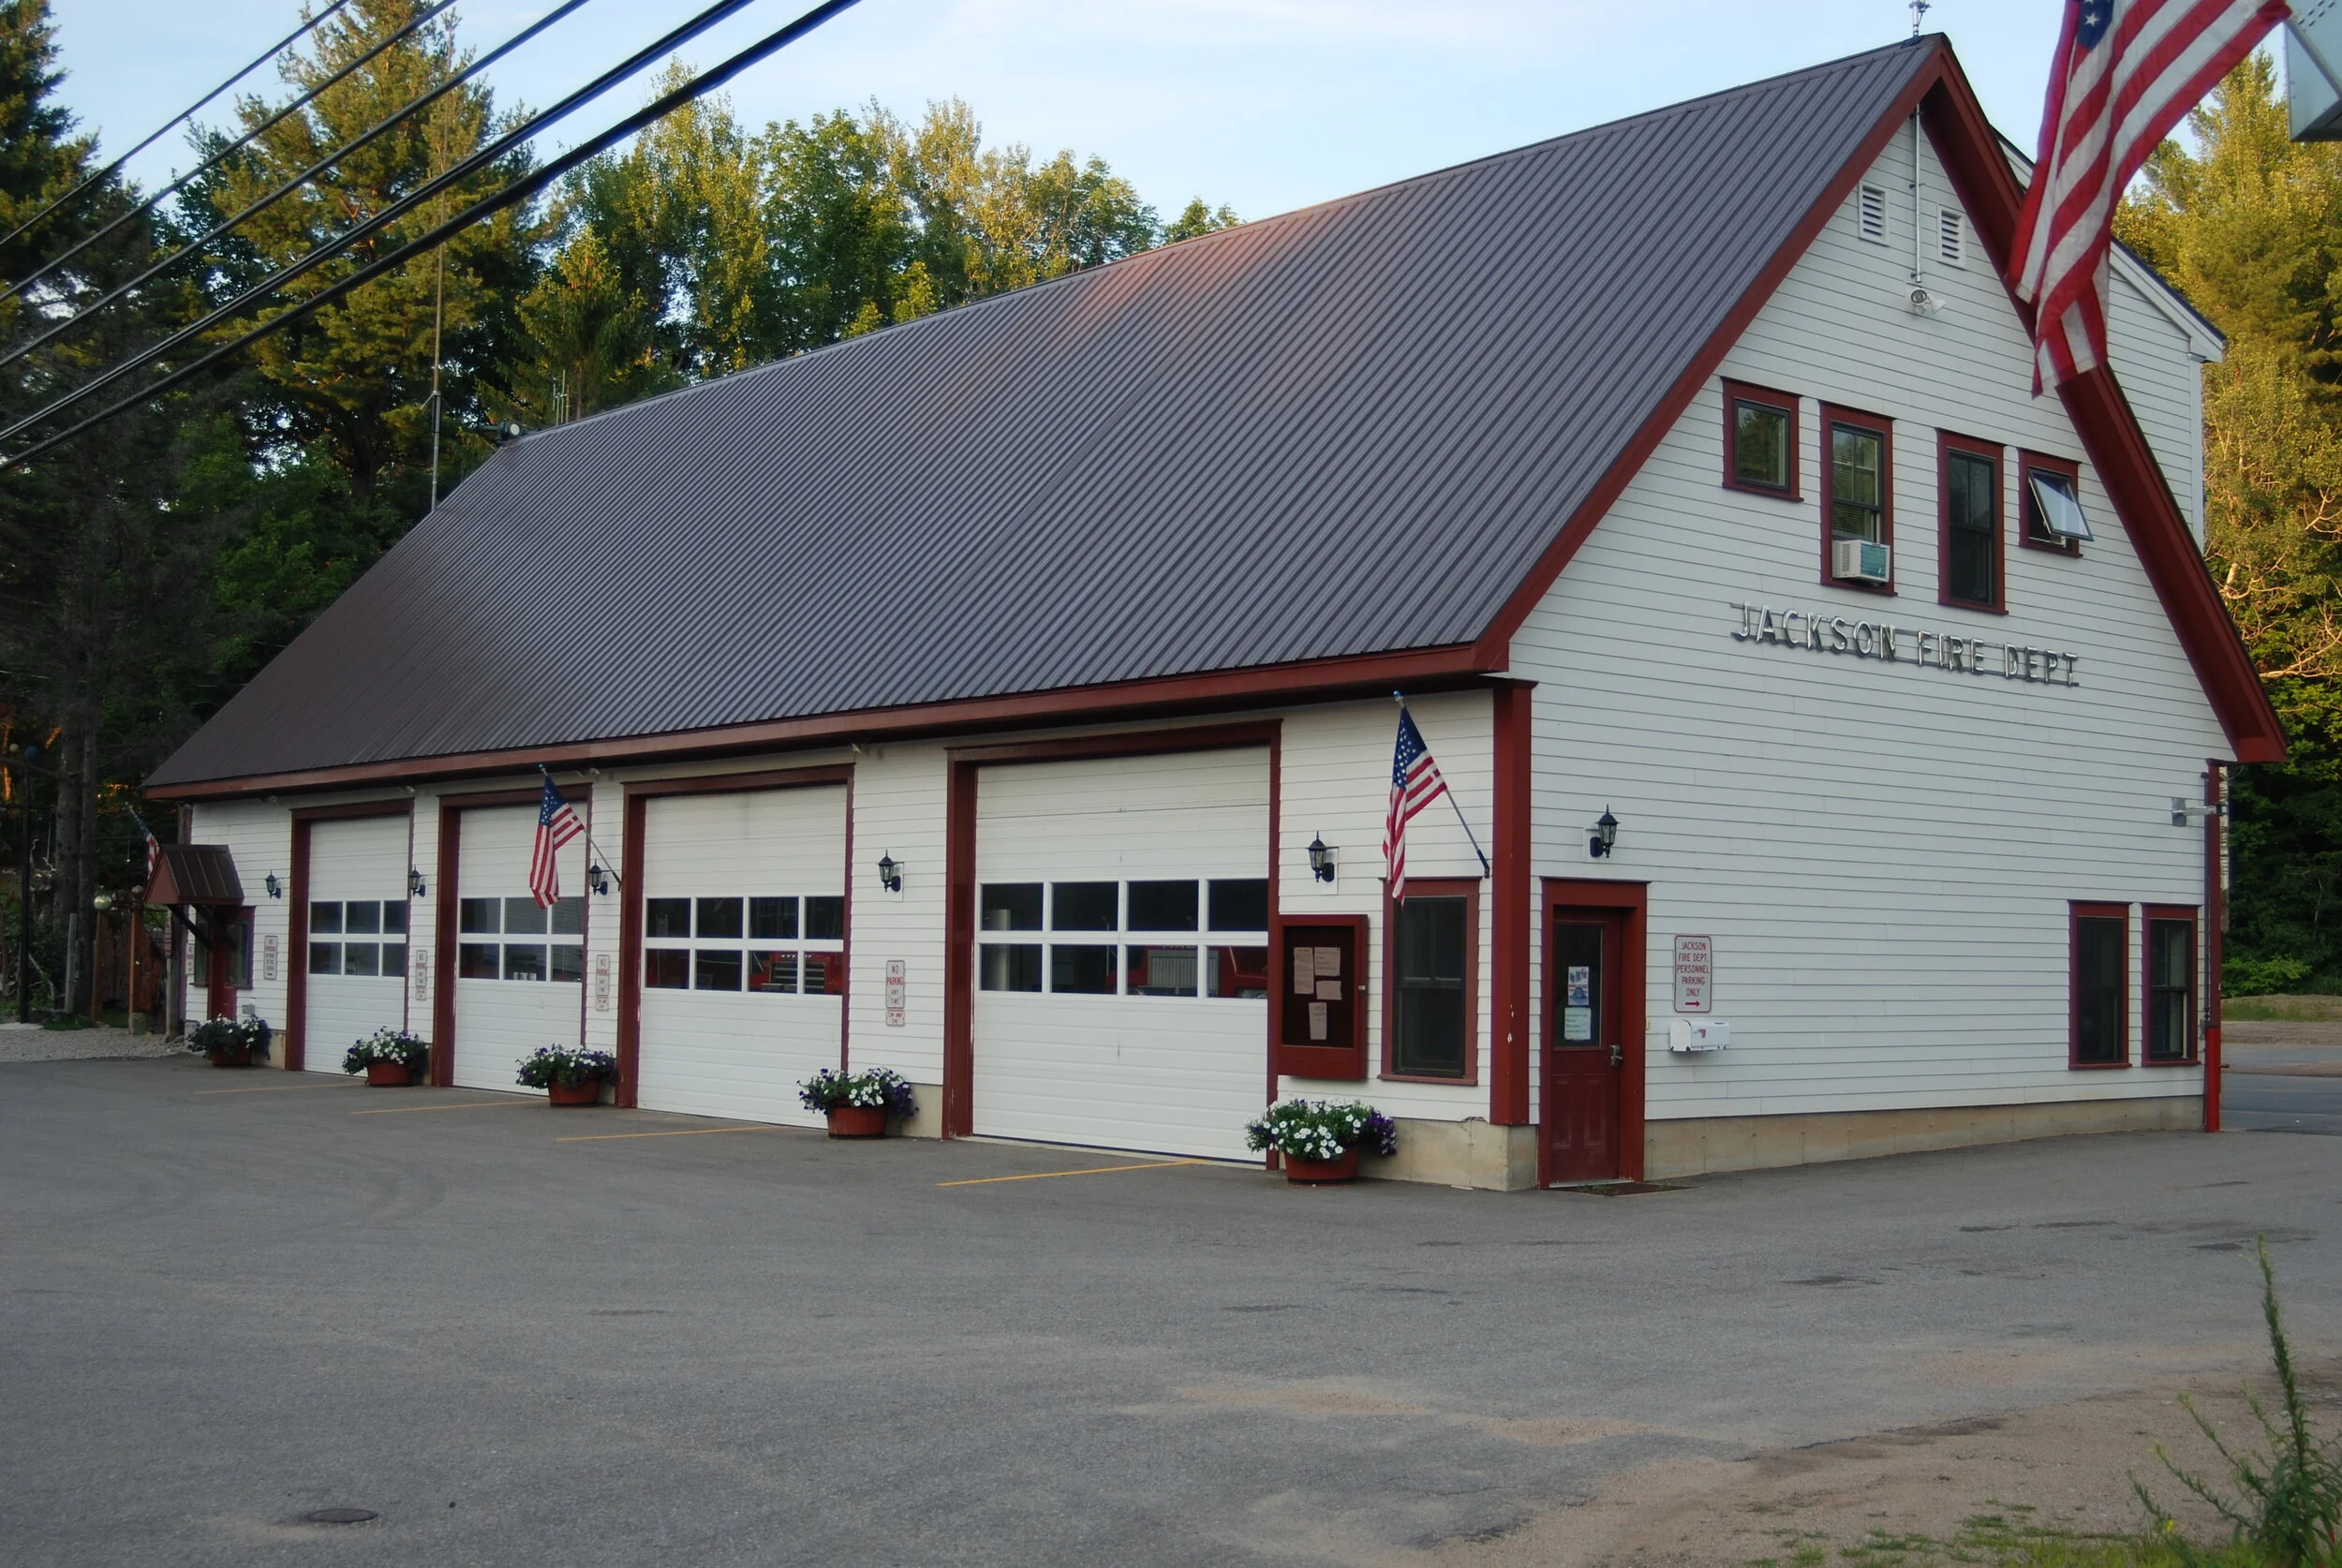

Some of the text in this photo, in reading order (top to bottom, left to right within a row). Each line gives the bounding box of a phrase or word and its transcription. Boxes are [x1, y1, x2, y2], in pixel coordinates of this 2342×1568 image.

[1730, 601, 2081, 688] JACKSON FIRE DEPT
[1681, 941, 1707, 950] JACKSON
[1678, 954, 1710, 963] FIRE DEPT.
[891, 965, 899, 974] NO
[1677, 965, 1710, 973] PERSONNEL
[886, 977, 905, 985] PARKING
[1682, 976, 1706, 985] PARKING
[1686, 988, 1700, 997] ONLY
